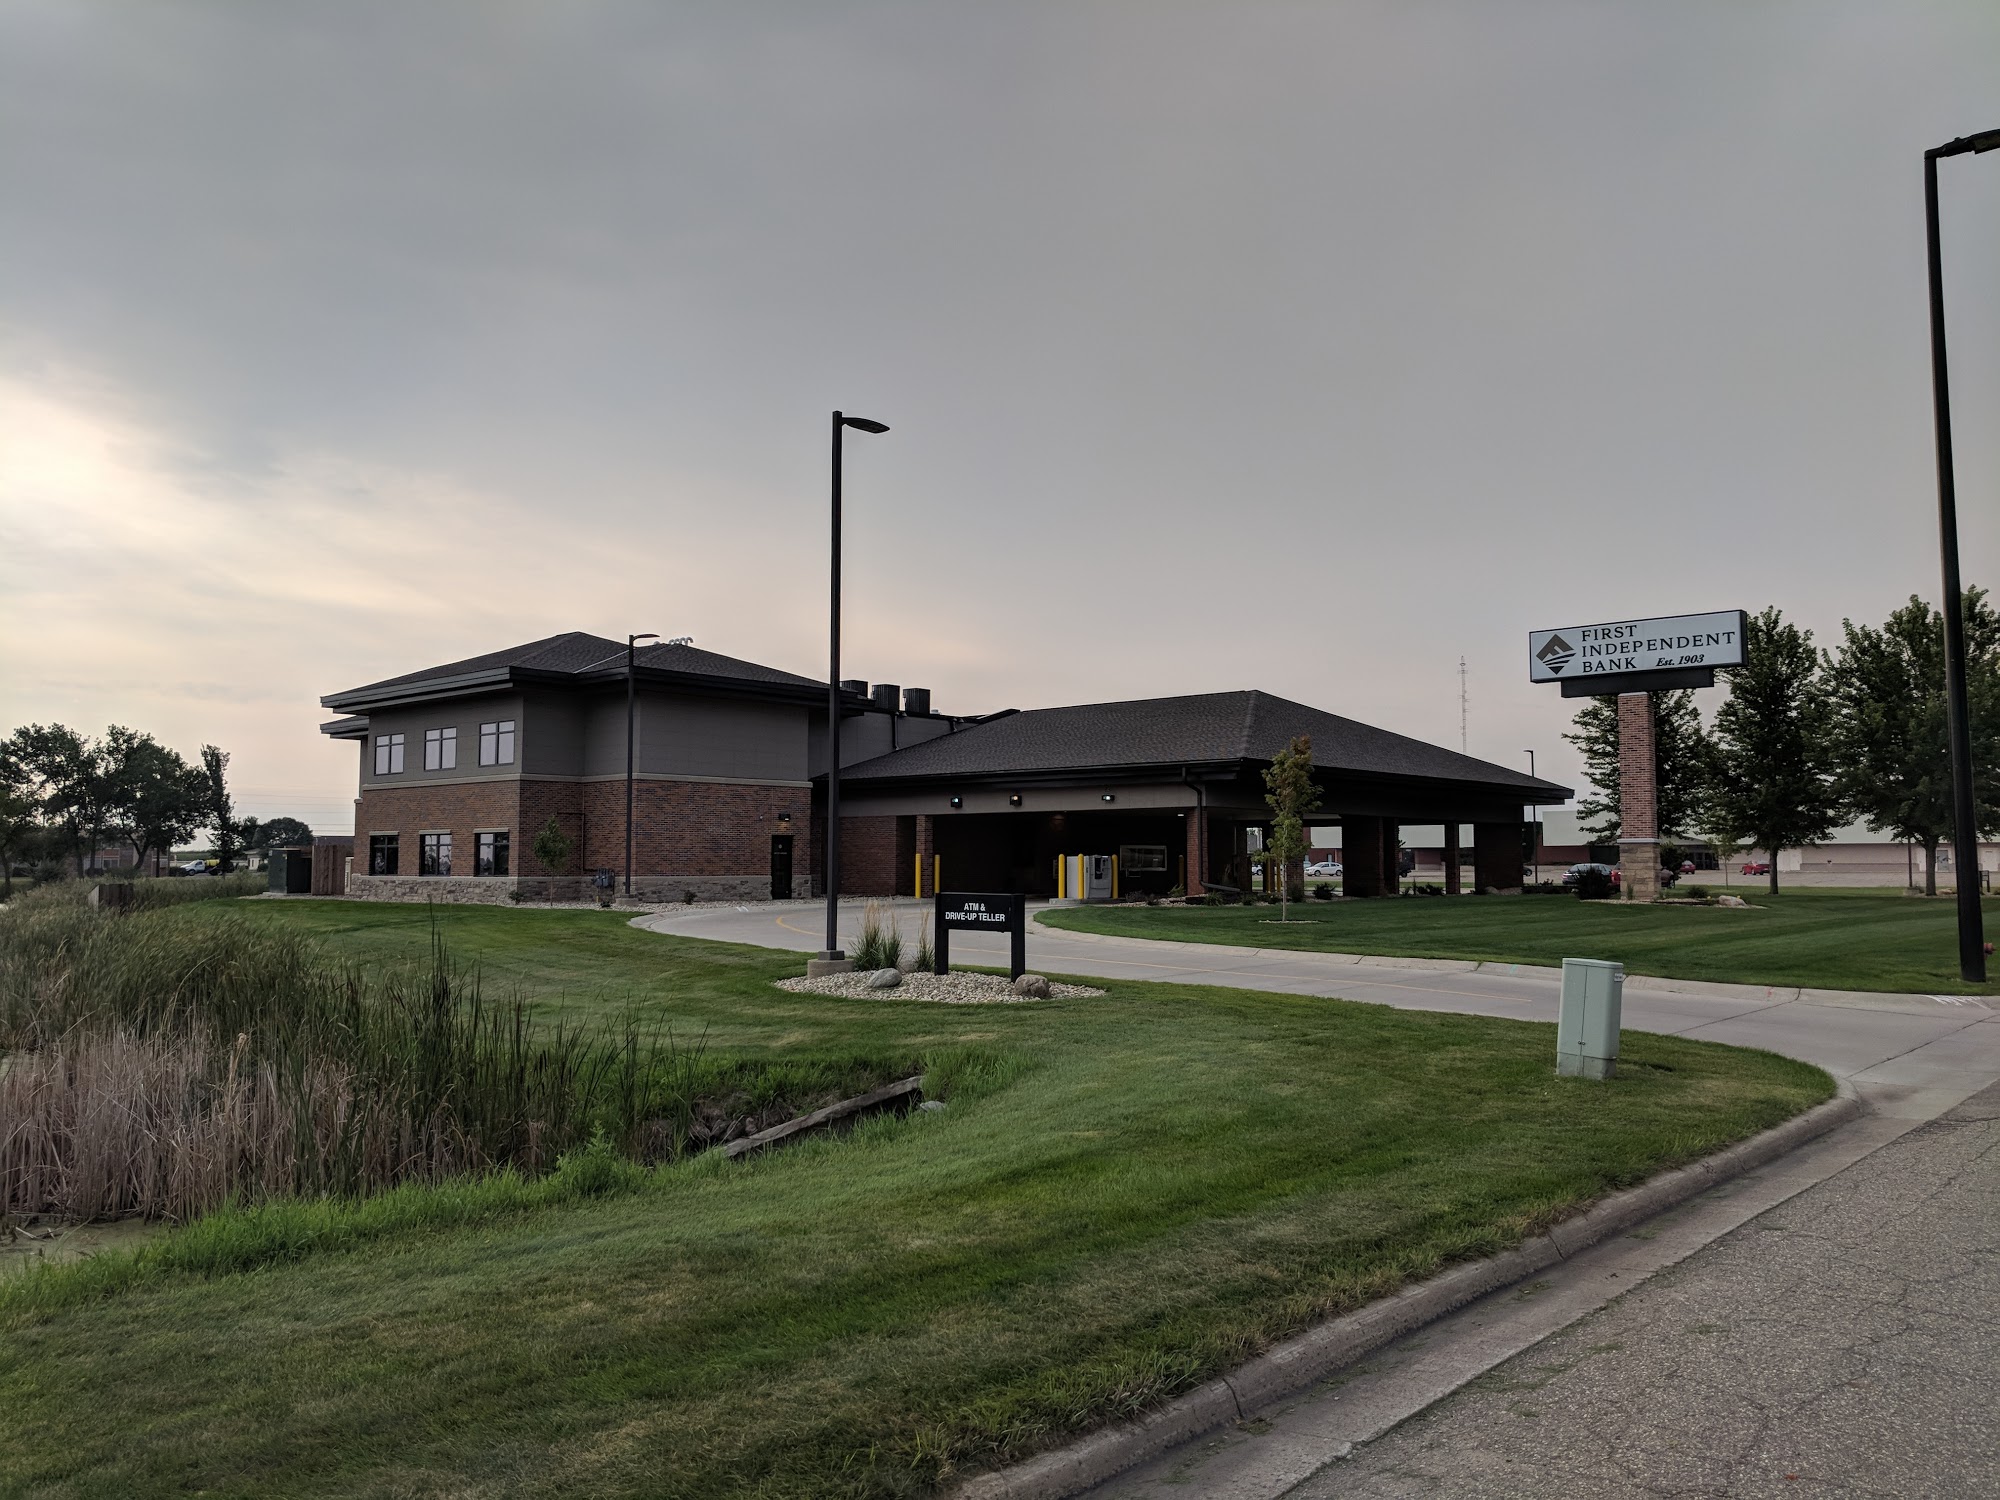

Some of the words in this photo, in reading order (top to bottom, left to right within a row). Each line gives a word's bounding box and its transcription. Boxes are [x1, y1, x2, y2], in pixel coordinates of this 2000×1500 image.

[1581, 625, 1637, 642] FIRST
[1582, 631, 1735, 658] INDEPENDENT
[1582, 657, 1637, 673] BANK
[1656, 657, 1675, 667] Est.
[1678, 654, 1705, 665] 1903
[963, 903, 979, 911] ATM
[980, 903, 986, 911] &
[945, 912, 977, 920] DRIVE-UP
[978, 913, 1005, 922] TELLER
